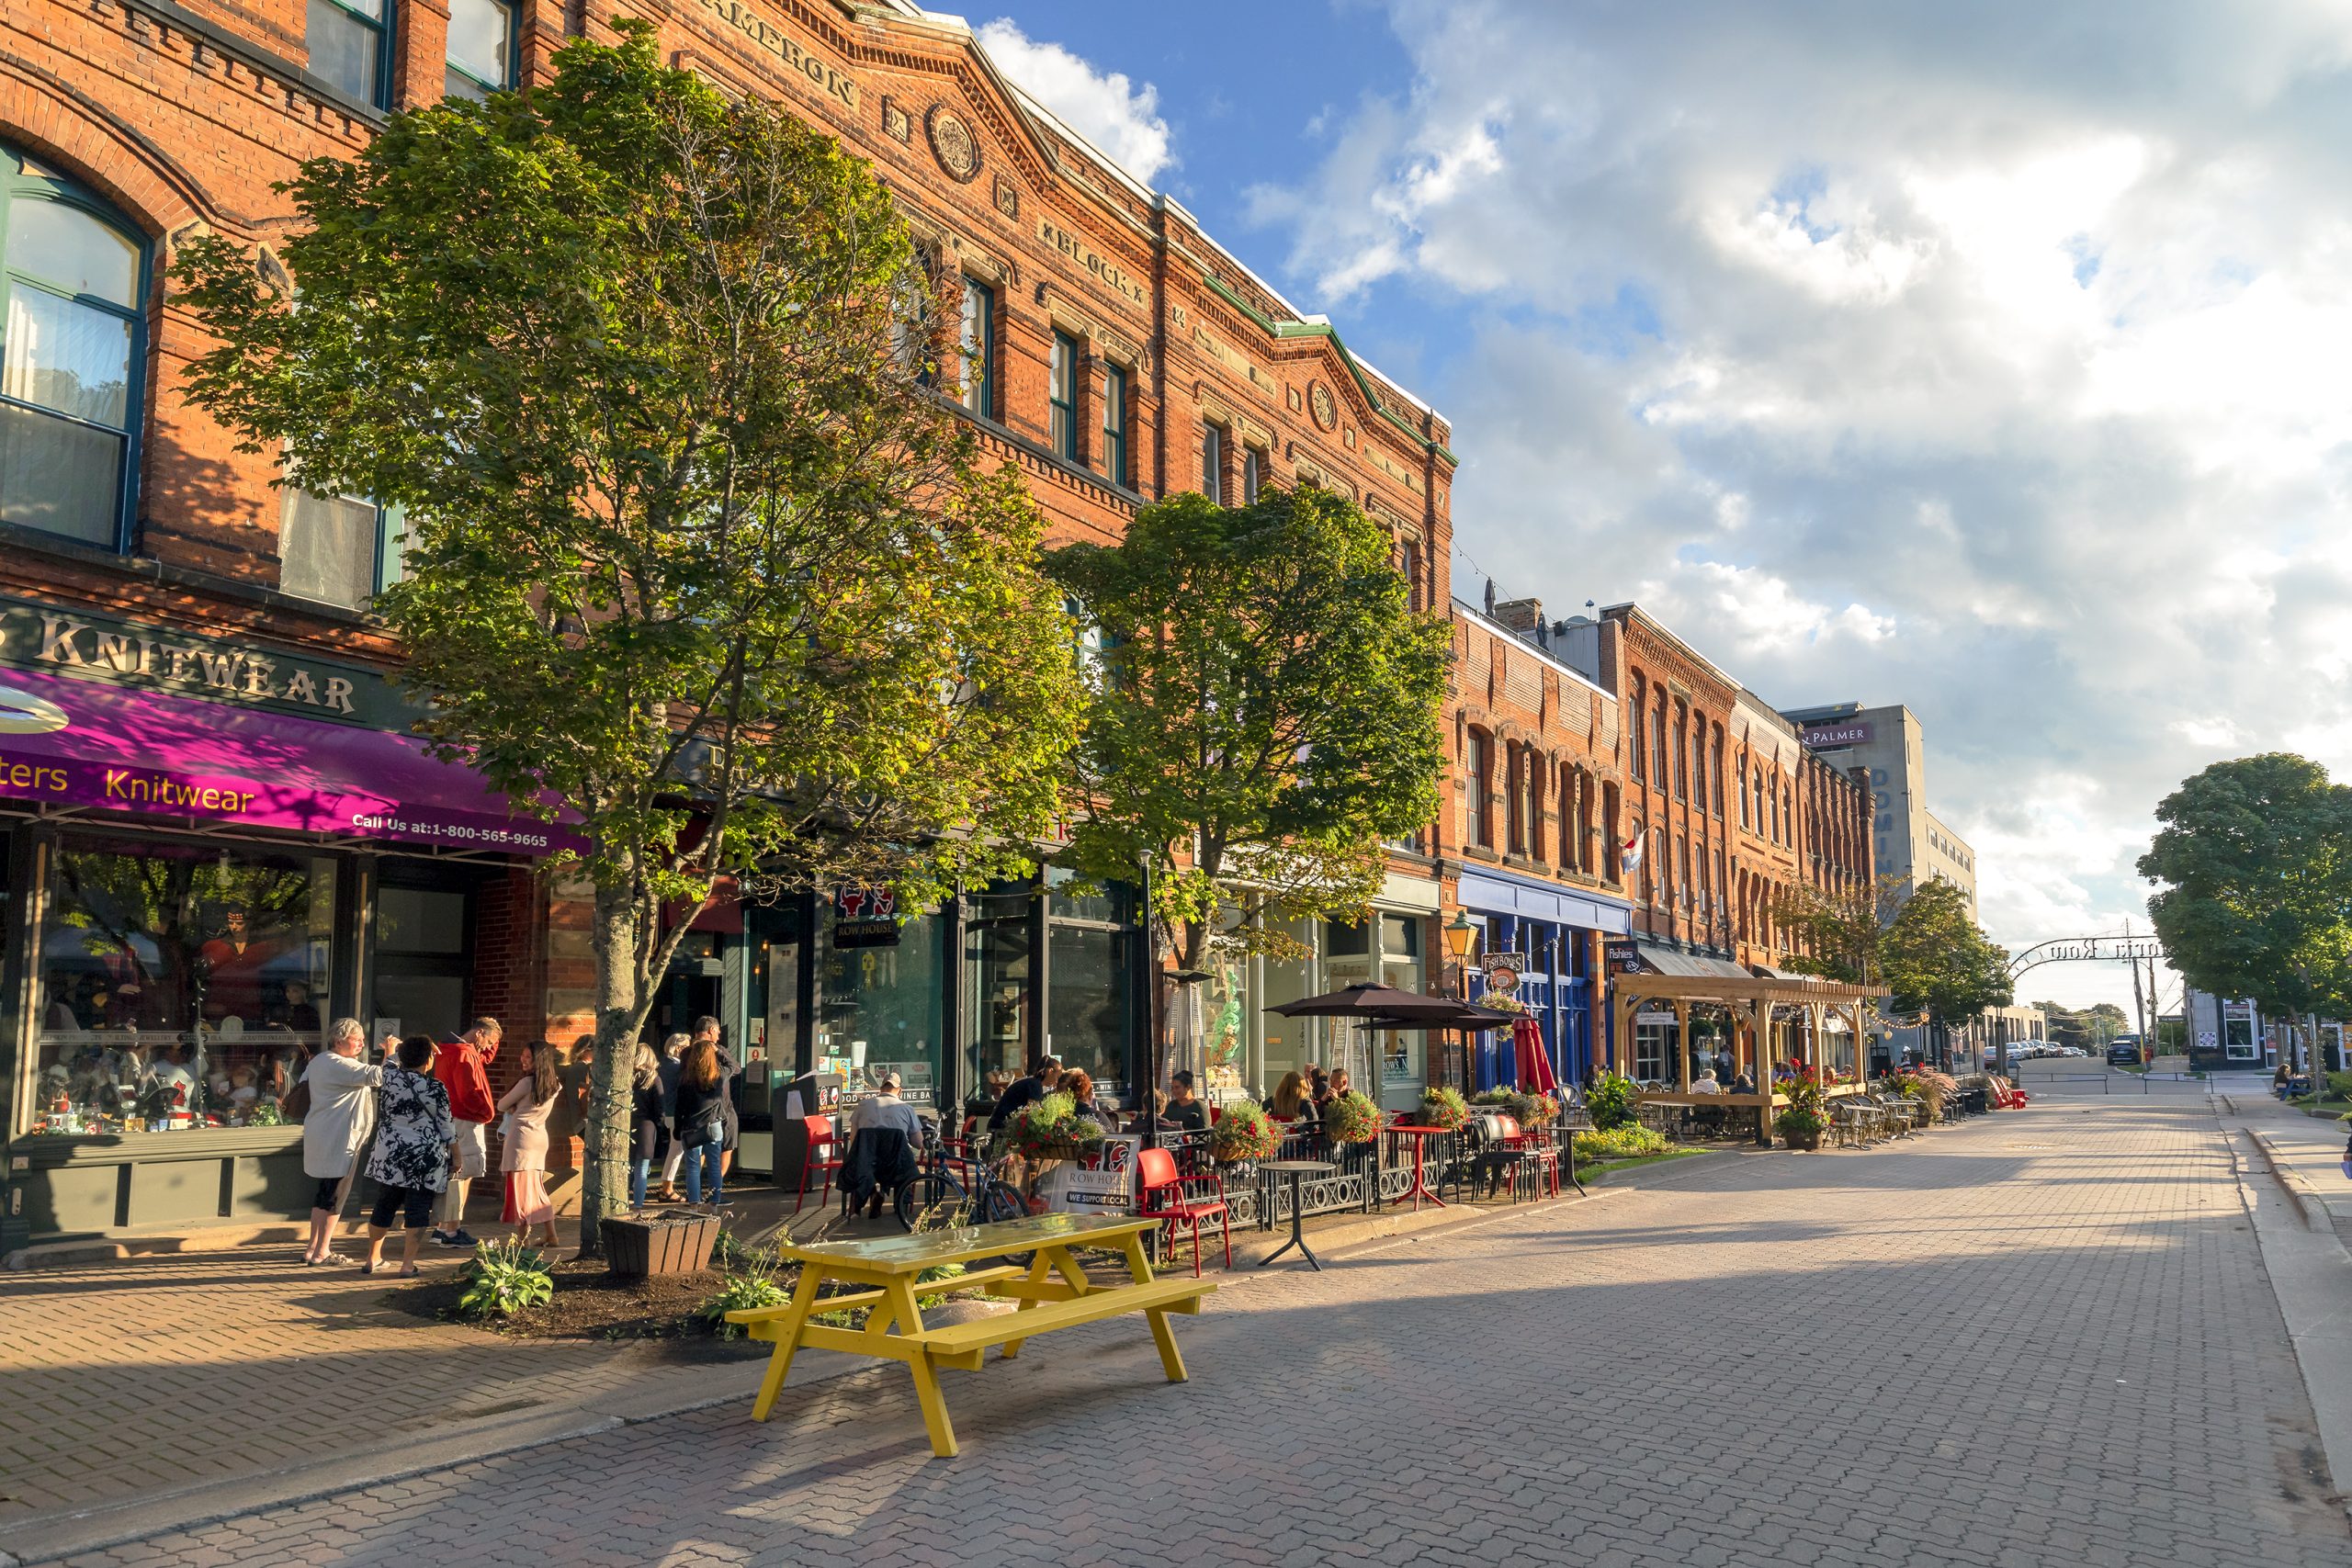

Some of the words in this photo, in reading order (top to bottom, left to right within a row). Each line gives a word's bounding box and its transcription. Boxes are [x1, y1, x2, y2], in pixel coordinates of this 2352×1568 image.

[1057, 230, 1132, 299] BLOCK
[34, 615, 356, 715] KNITWEAR
[1813, 729, 1864, 743] PALMER
[105, 769, 255, 813] Knitwear
[352, 814, 382, 829] Call
[387, 818, 407, 831] Us
[838, 926, 860, 936] ROW
[862, 924, 893, 934] HOUSE
[1069, 1173, 1095, 1183] ROW
[1069, 1194, 1080, 1202] WE
[1081, 1194, 1106, 1203] SUPPORT
[1107, 1196, 1128, 1205] LOCAL
